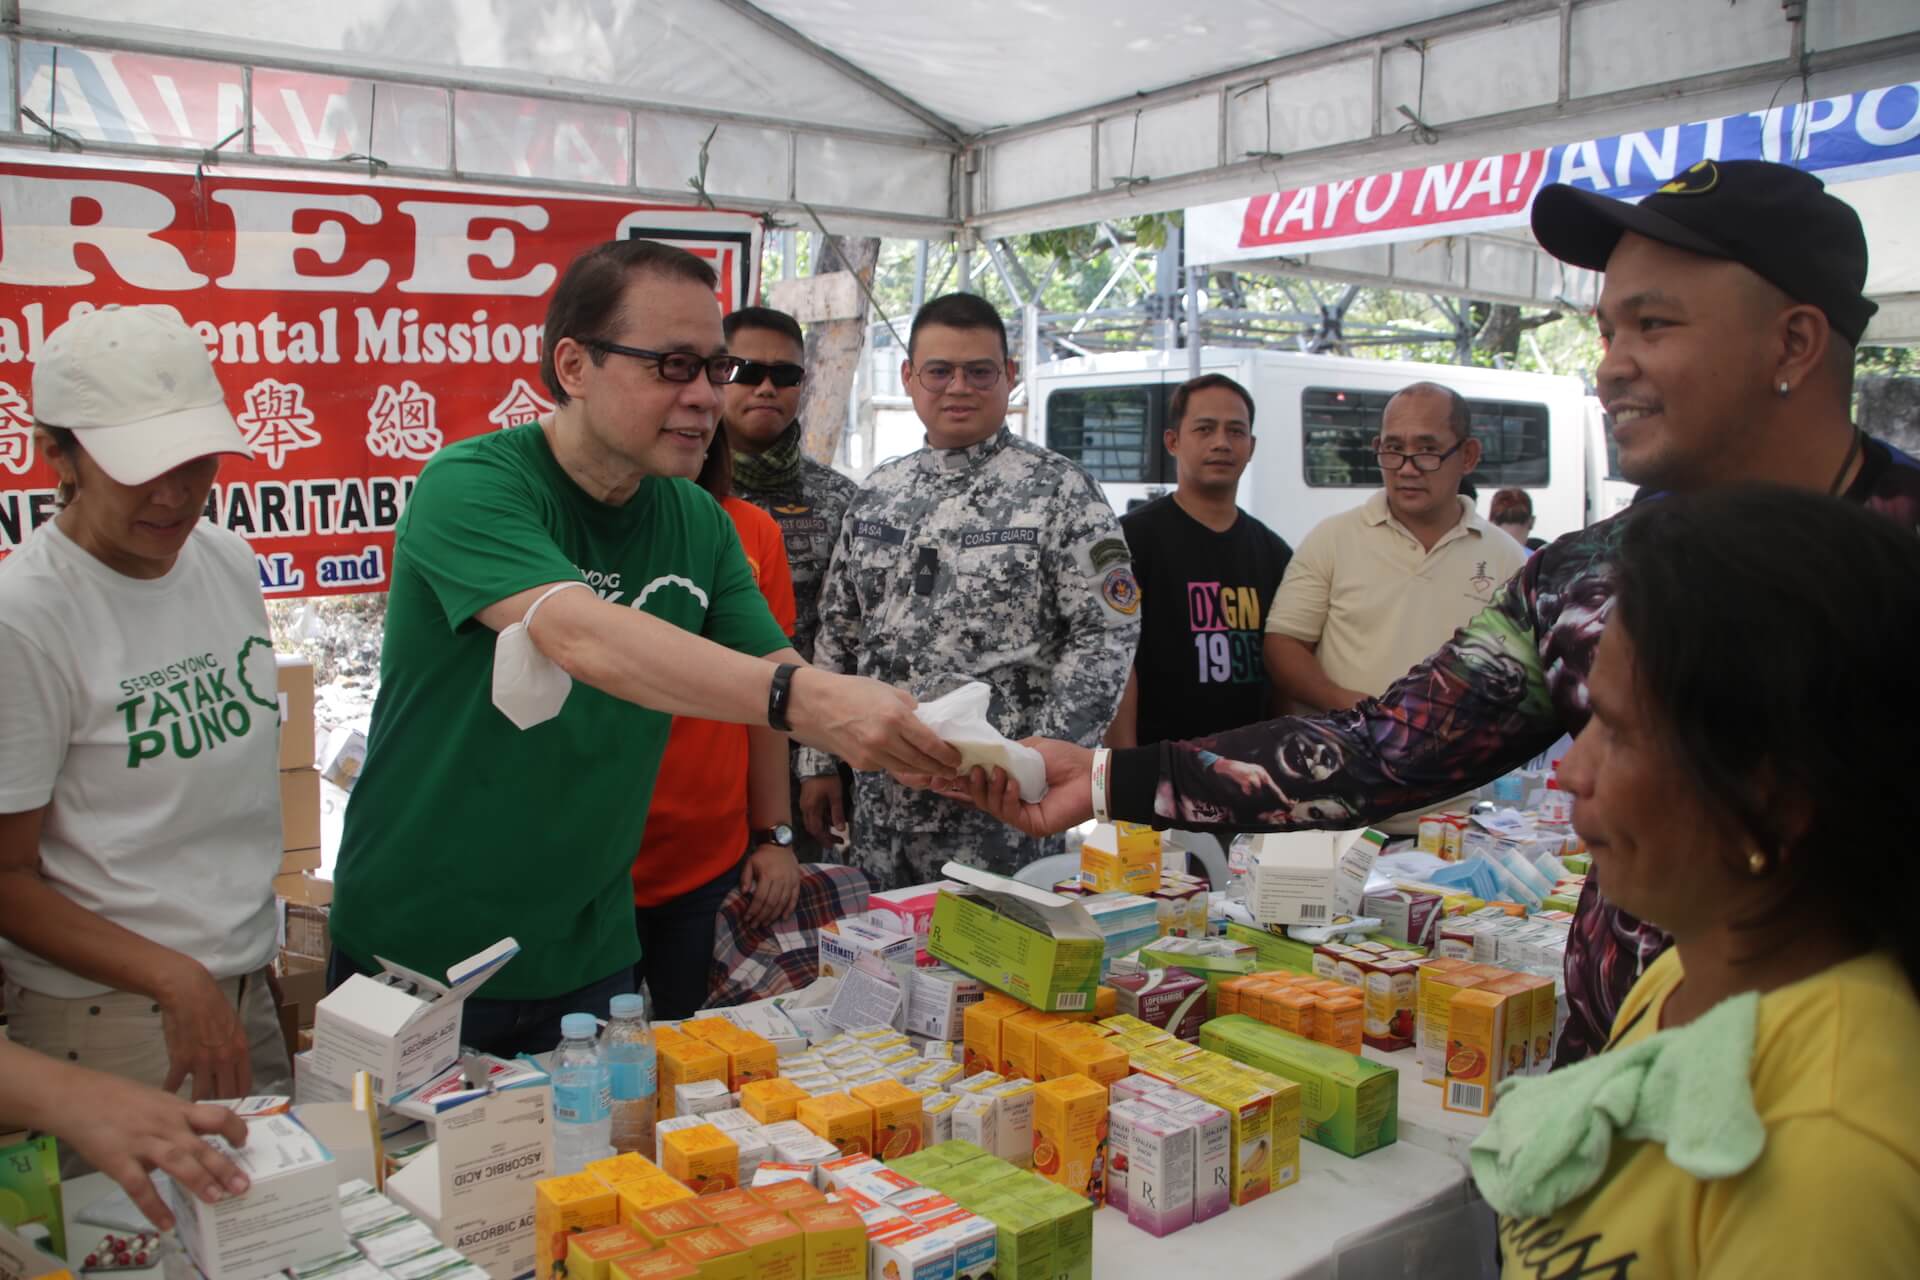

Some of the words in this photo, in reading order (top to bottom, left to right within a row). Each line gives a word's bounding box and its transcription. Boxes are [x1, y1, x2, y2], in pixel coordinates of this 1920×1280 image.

[140, 303, 340, 364] ental
[965, 532, 998, 546] COAST
[1000, 529, 1035, 543] GUARD
[322, 550, 379, 583] and
[120, 653, 219, 696] SERBISYONG
[116, 668, 236, 733] TATAK
[127, 700, 250, 768] PUNO
[455, 1169, 482, 1186] ACID
[486, 1152, 542, 1174] ASCORBIC
[457, 1220, 517, 1248] ASCORBIC
